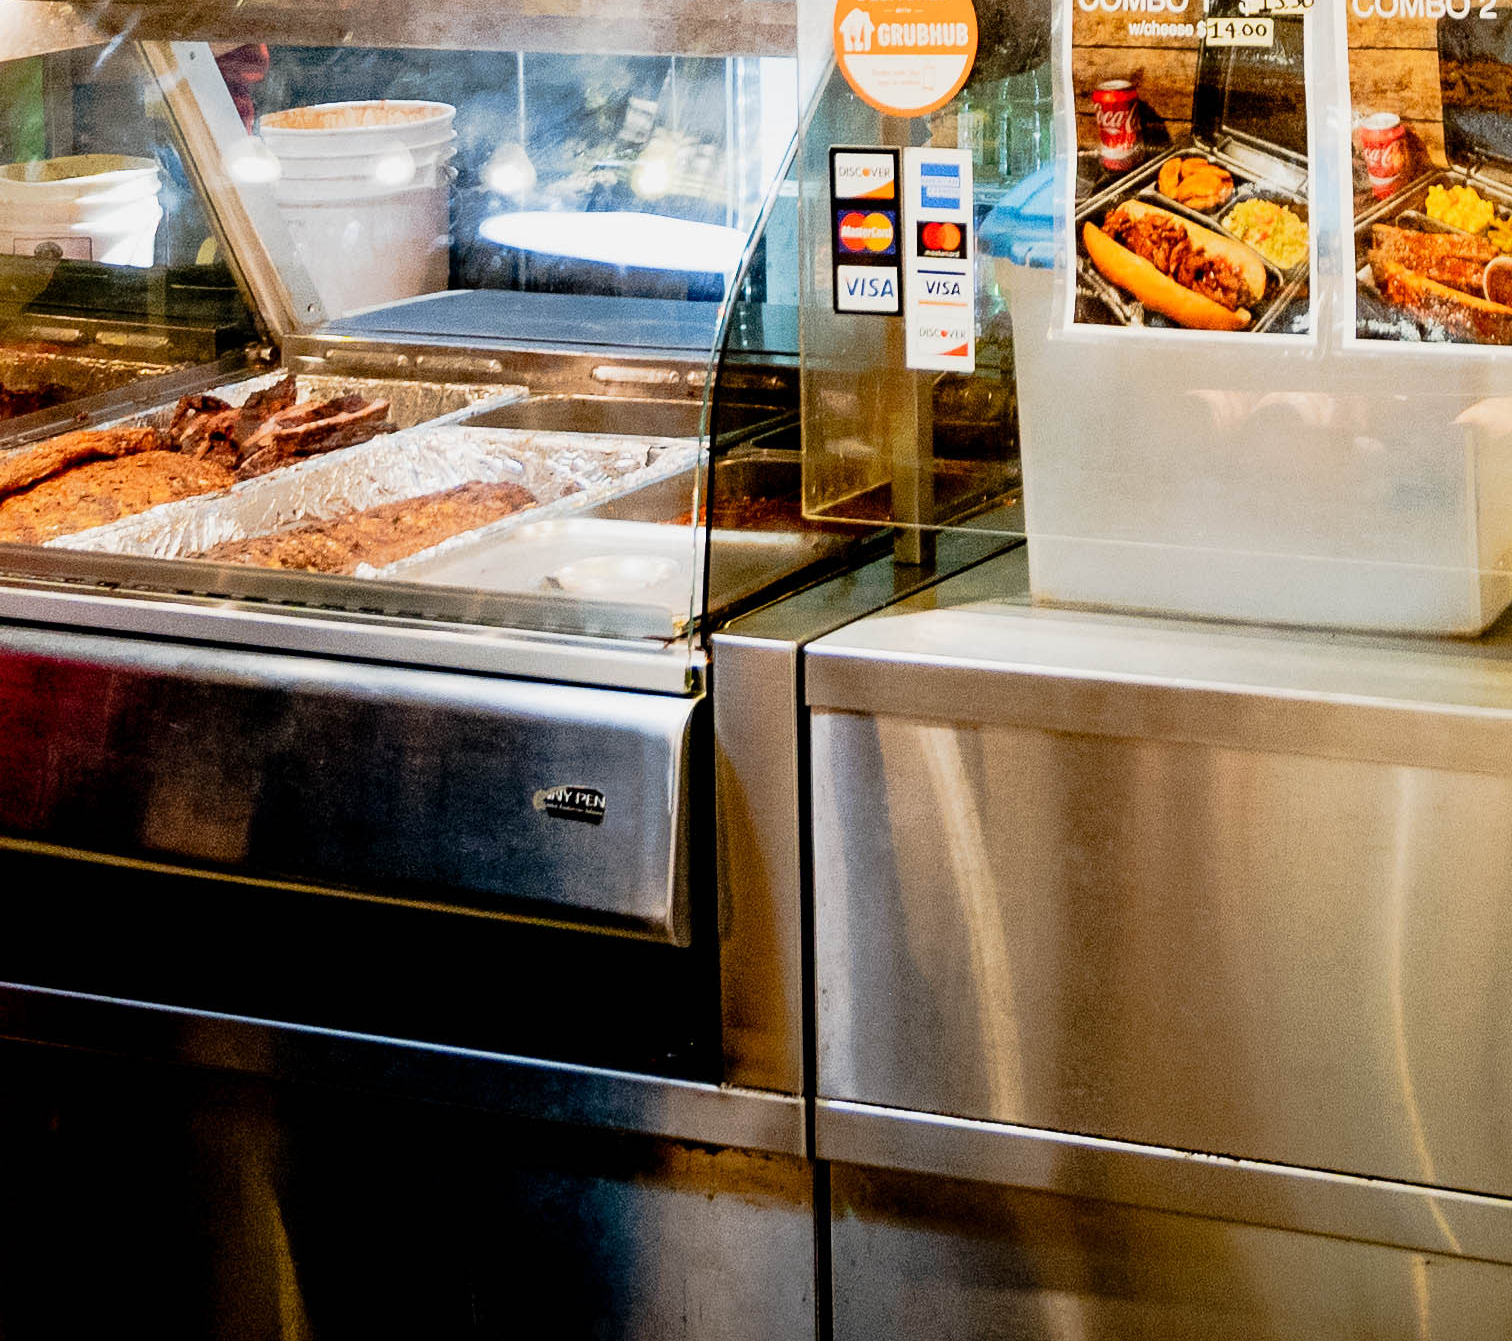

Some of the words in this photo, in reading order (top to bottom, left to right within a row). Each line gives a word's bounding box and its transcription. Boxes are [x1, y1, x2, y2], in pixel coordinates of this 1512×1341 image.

[878, 22, 968, 46] GRUBHUB
[1129, 21, 1194, 37] w/cheese
[839, 167, 890, 178] DISCOVER
[841, 226, 892, 238] MasterCard
[847, 278, 894, 297] VISA
[926, 280, 960, 295] VISA
[920, 327, 966, 339] DISCOVER
